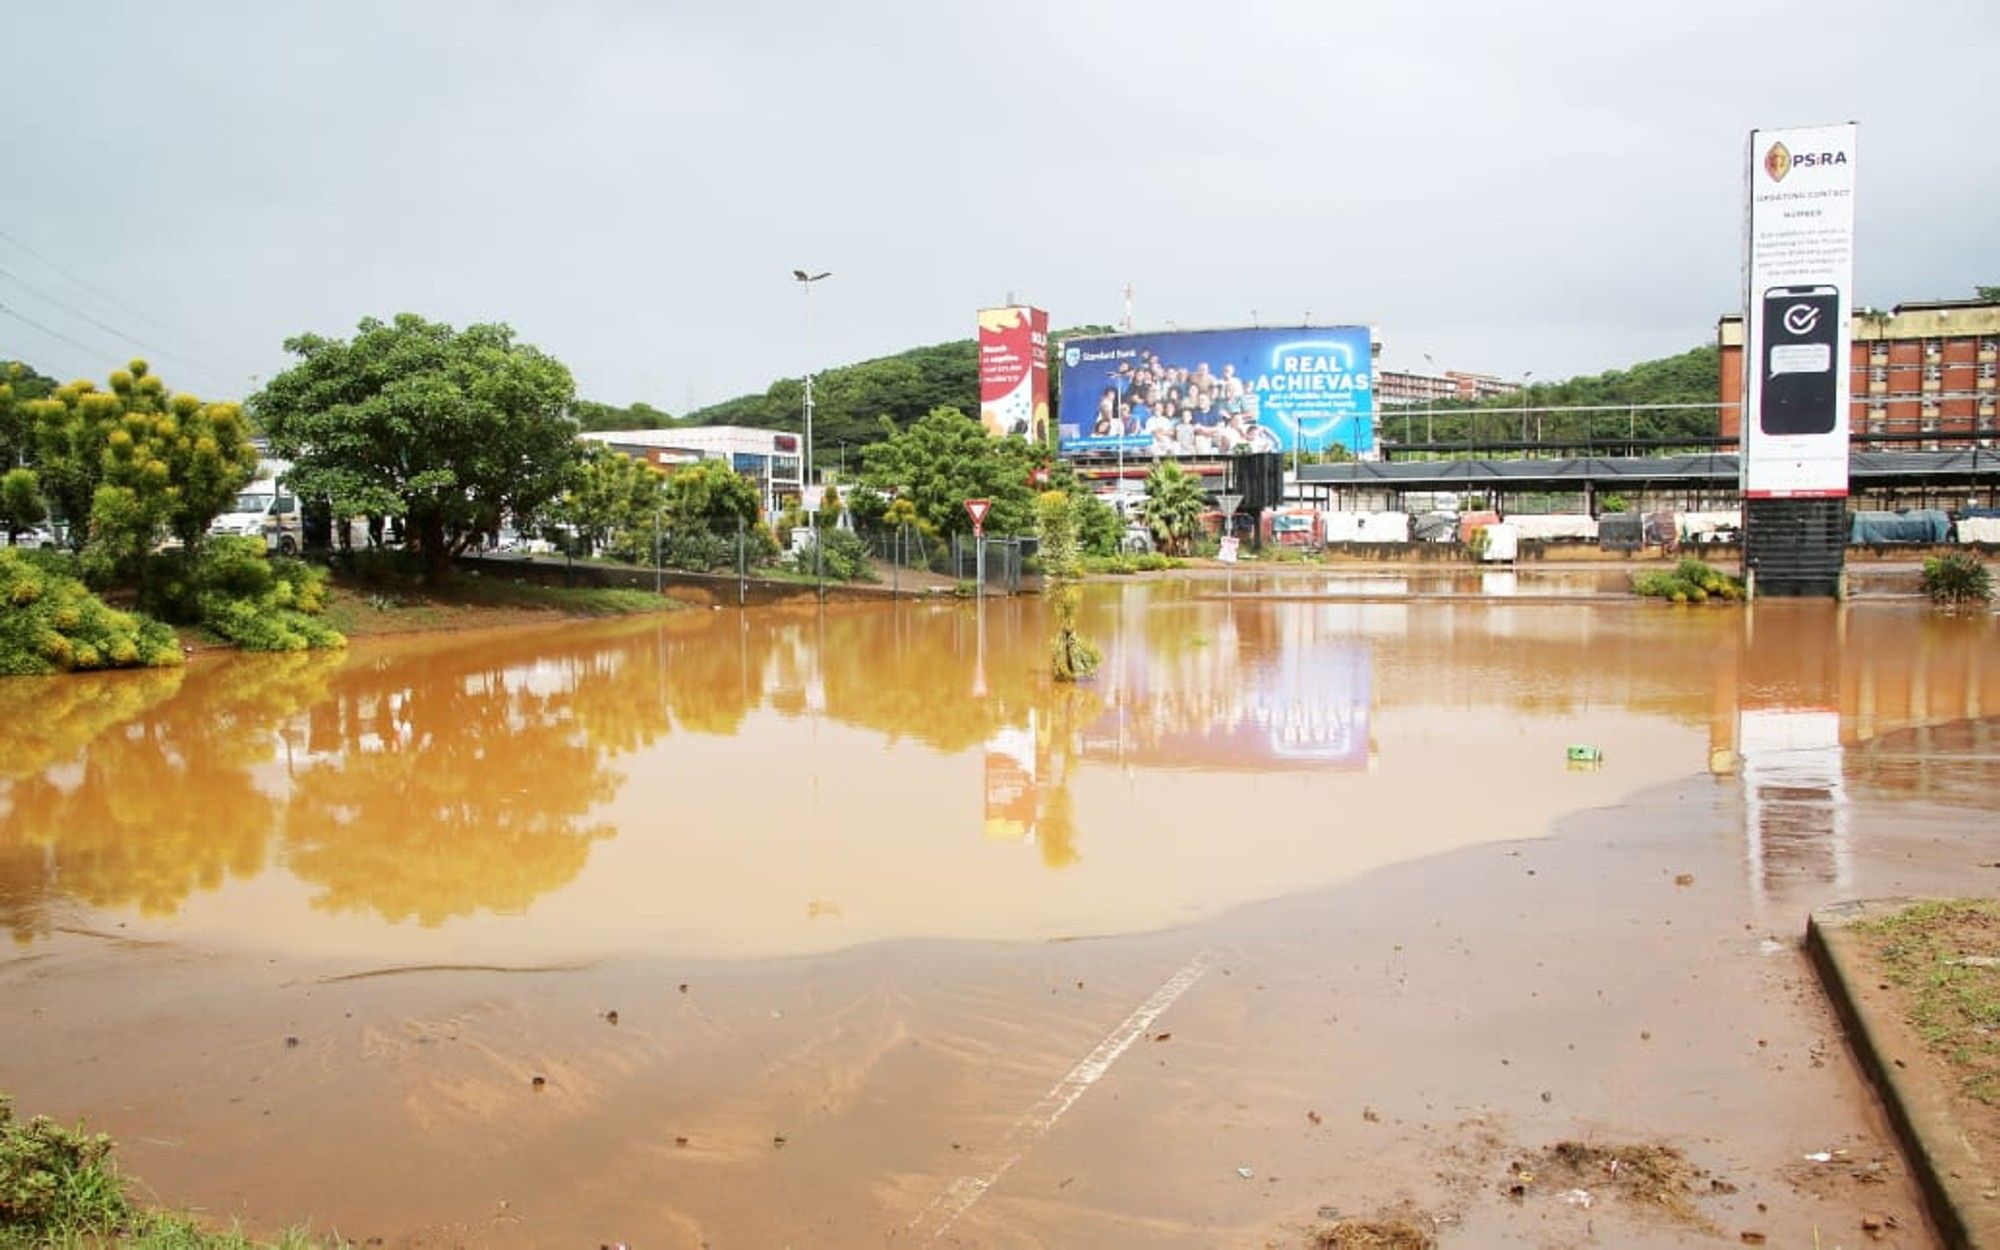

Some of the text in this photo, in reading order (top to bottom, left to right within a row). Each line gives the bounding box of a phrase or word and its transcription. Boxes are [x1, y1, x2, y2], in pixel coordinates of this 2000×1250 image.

[1083, 349, 1115, 361] Standard
[1284, 355, 1343, 373] REAL
[1255, 373, 1369, 391] ACHIEVAS
